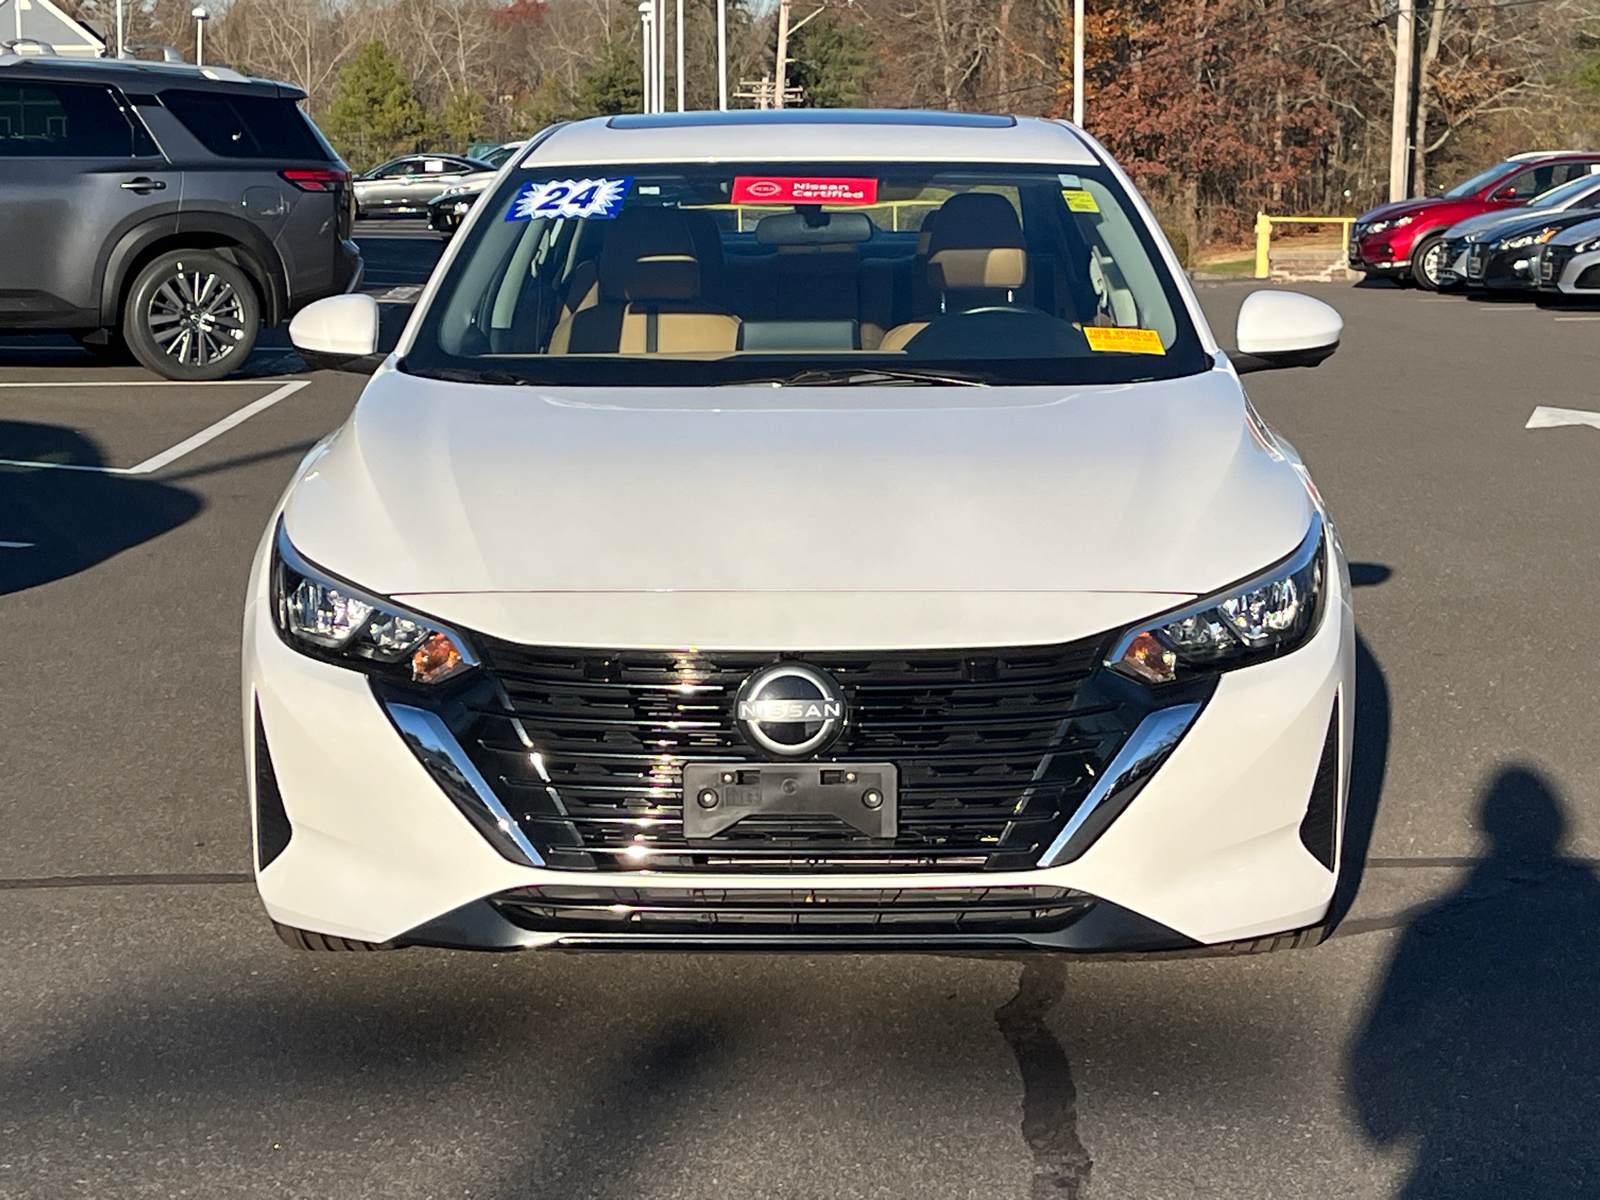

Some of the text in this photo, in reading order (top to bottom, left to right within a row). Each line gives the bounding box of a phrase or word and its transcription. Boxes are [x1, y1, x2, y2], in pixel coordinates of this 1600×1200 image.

[793, 182, 849, 190] Nissan
[535, 185, 600, 211] 24
[792, 189, 864, 198] Certified
[741, 702, 840, 718] NISSAN
